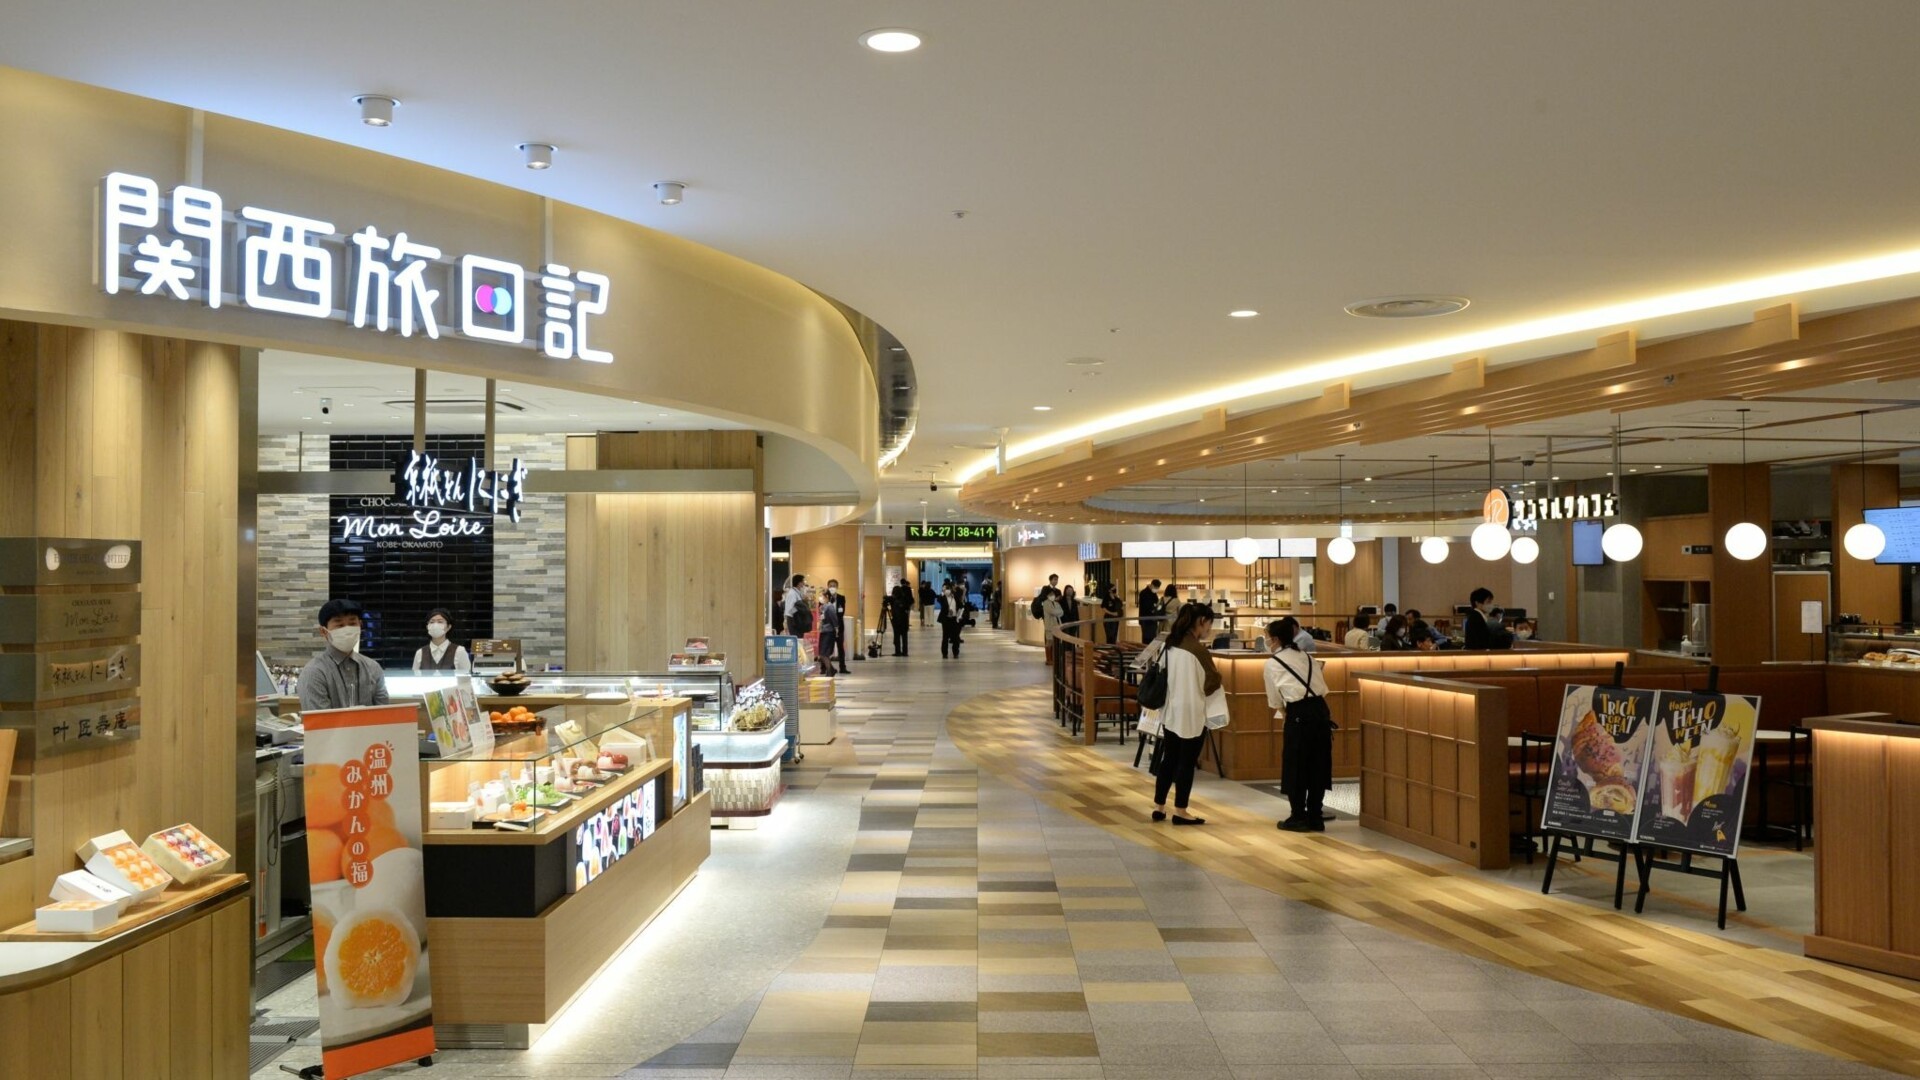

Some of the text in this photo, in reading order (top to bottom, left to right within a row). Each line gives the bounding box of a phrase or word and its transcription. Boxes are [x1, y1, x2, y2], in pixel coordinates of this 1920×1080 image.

[106, 171, 614, 364] 関西旅日記
[338, 510, 485, 539] Mon Loire
[957, 526, 985, 537] 38-41
[1600, 693, 1639, 717] TRICK
[369, 748, 388, 796] 温州
[346, 765, 369, 884] みかんの福
